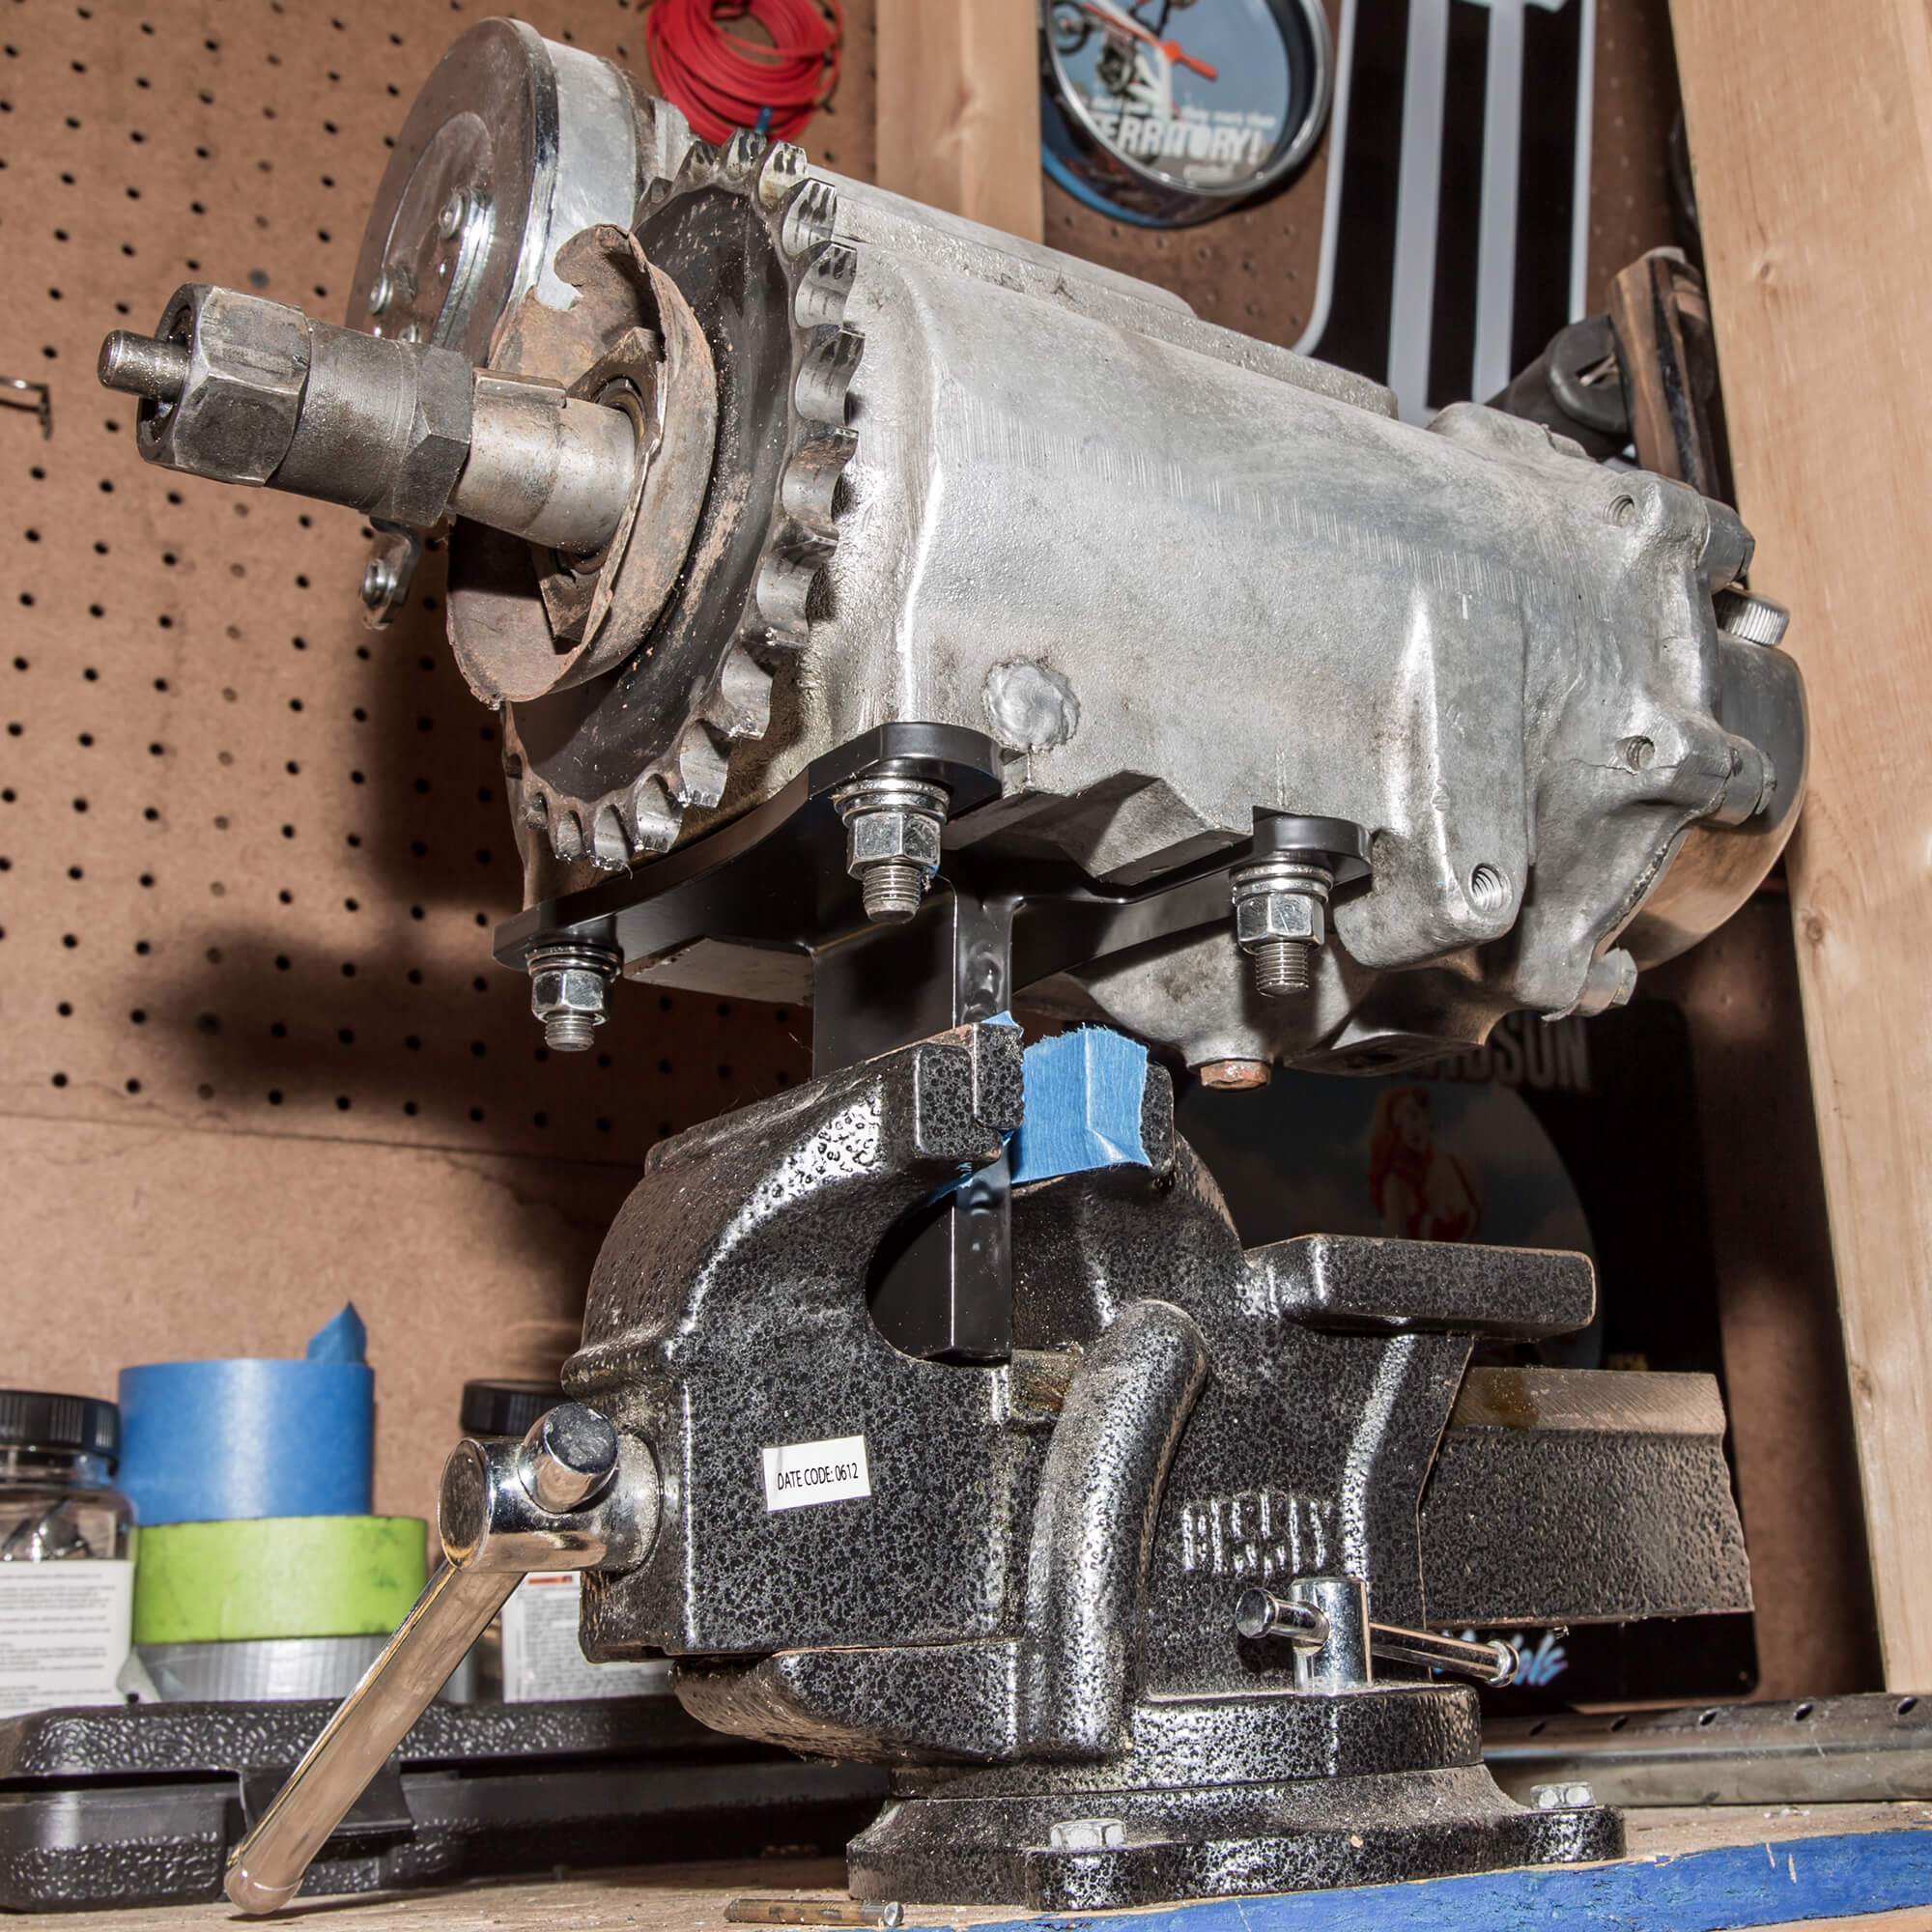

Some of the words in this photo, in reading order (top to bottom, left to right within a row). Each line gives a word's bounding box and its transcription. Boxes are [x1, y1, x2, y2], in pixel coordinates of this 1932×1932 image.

[777, 1470, 803, 1491] DATE
[804, 1465, 835, 1486] CODE:
[835, 1462, 859, 1481] 0612
